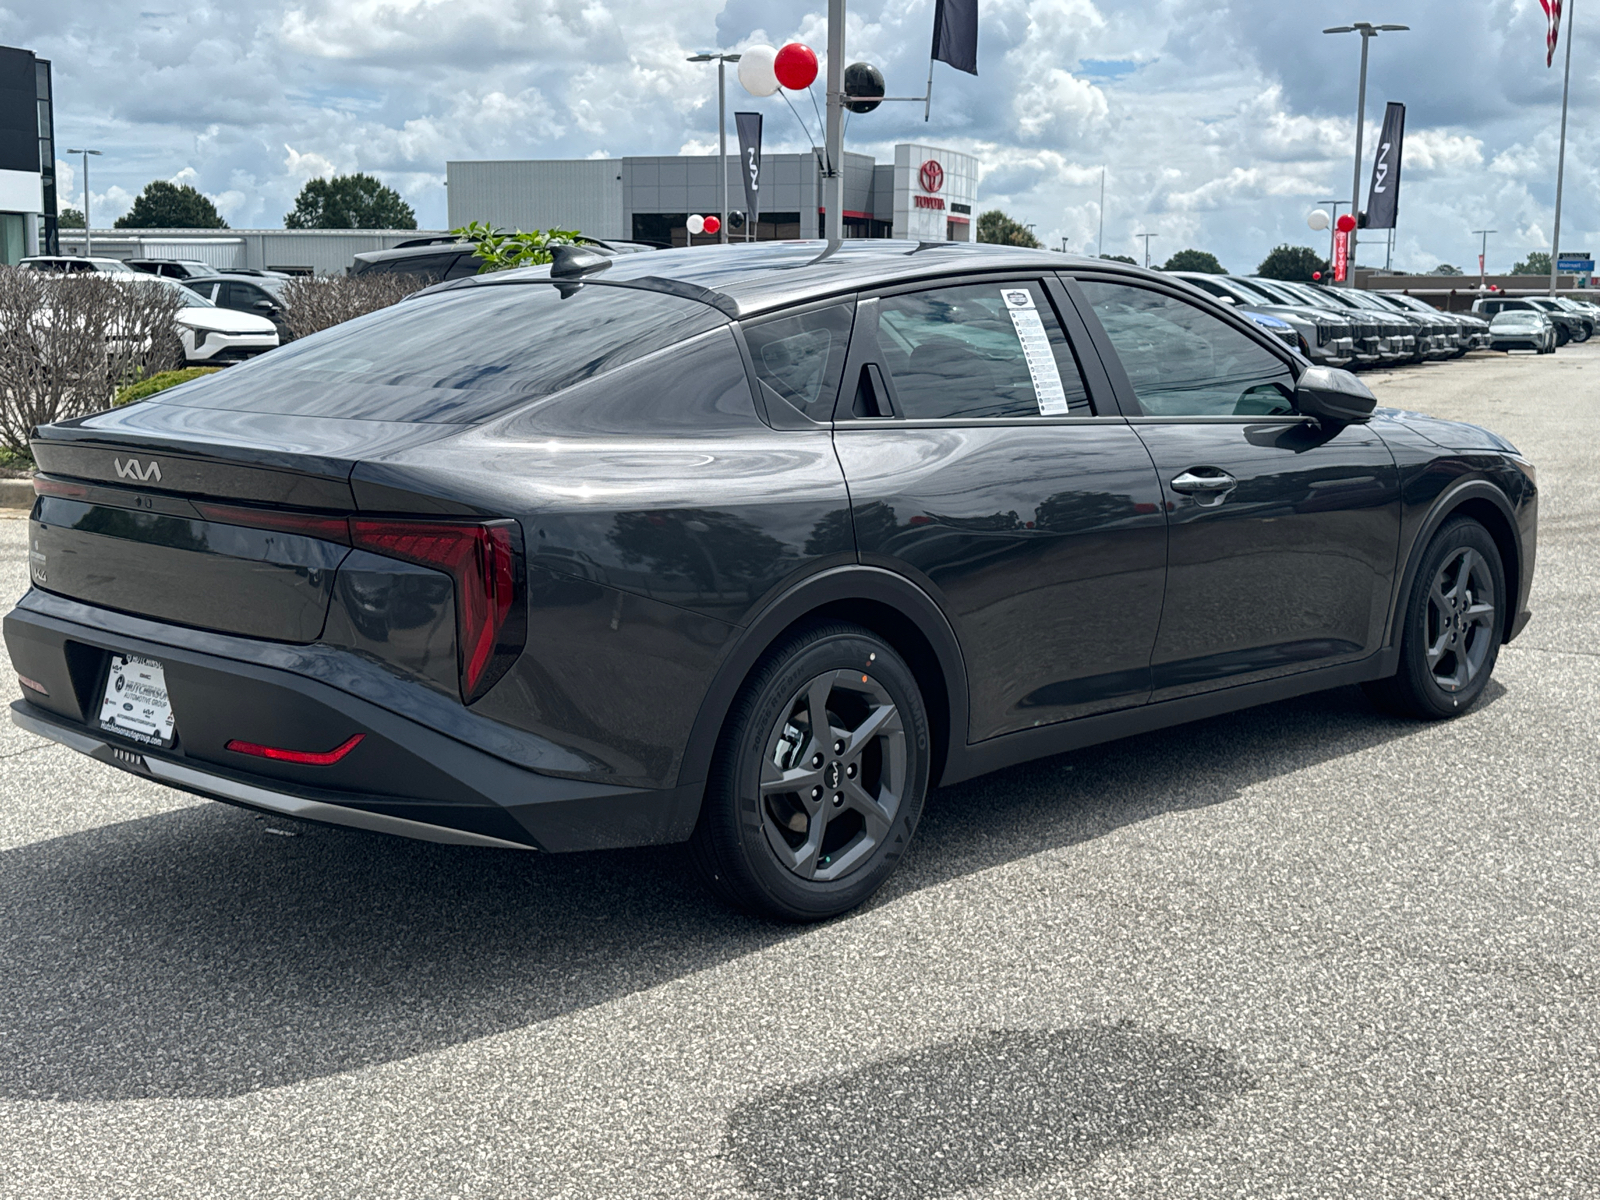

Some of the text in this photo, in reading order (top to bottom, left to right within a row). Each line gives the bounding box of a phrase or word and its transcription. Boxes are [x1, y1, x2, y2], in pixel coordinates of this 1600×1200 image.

[914, 195, 945, 210] TOYOTA
[114, 457, 162, 482] KIA
[124, 692, 151, 705] AUTOMOTIVE
[151, 698, 167, 708] GROUP
